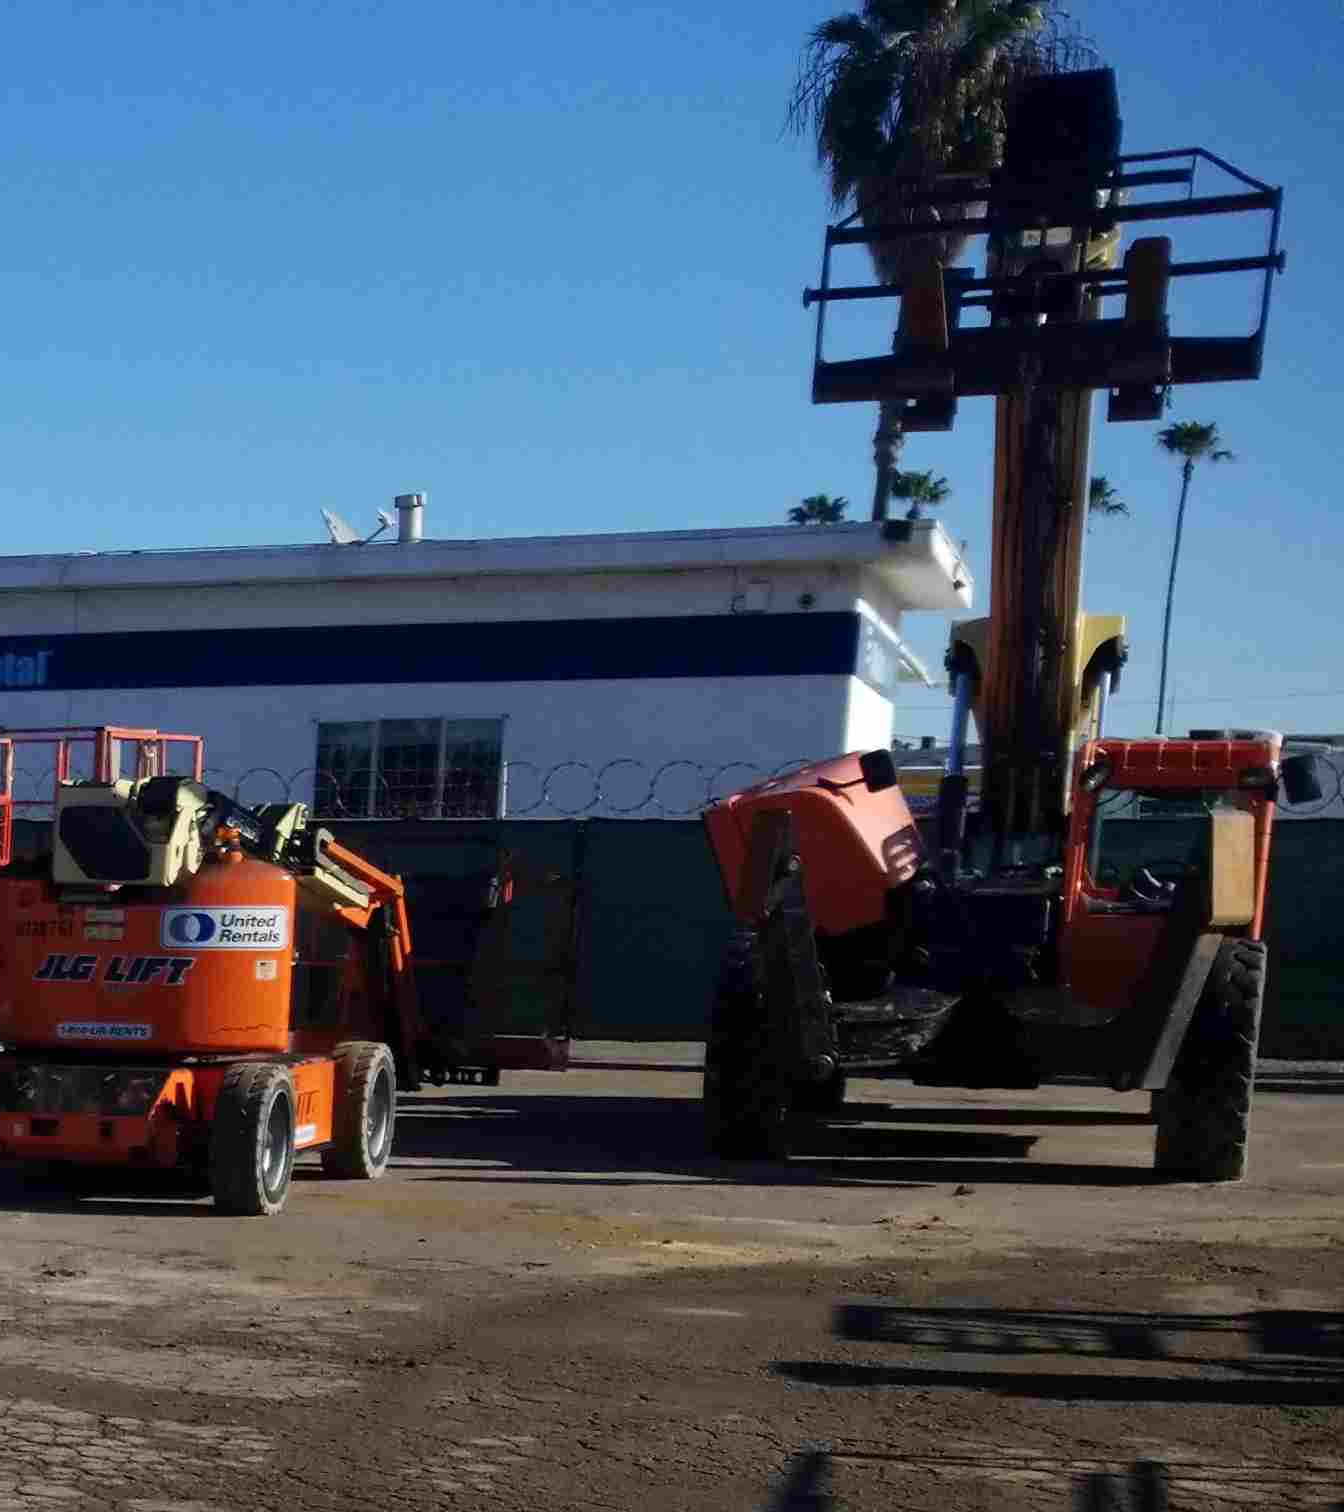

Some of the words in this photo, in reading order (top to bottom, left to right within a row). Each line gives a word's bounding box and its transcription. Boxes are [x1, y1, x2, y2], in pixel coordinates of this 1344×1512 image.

[220, 914, 276, 928] United
[218, 929, 280, 943] Rentals
[33, 953, 97, 982] JLG
[103, 956, 197, 986] LIFT
